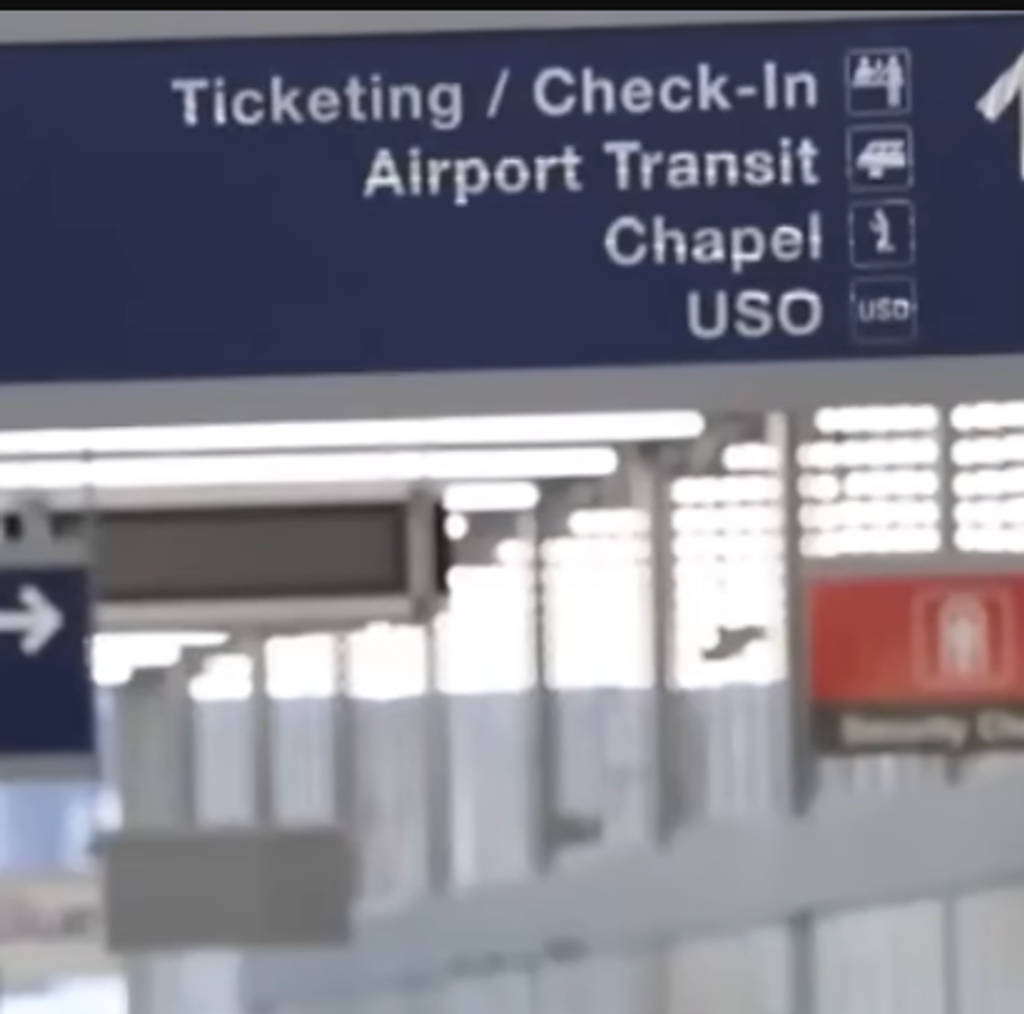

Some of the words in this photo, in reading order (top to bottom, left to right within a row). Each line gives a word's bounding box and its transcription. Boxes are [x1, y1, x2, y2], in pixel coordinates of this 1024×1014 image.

[172, 75, 464, 130] Ticketing
[487, 68, 510, 118] /
[532, 61, 818, 116] Check-In
[363, 145, 583, 206] Airport
[603, 137, 820, 192] Transit
[603, 211, 823, 274] Chapel
[686, 288, 824, 340] USO
